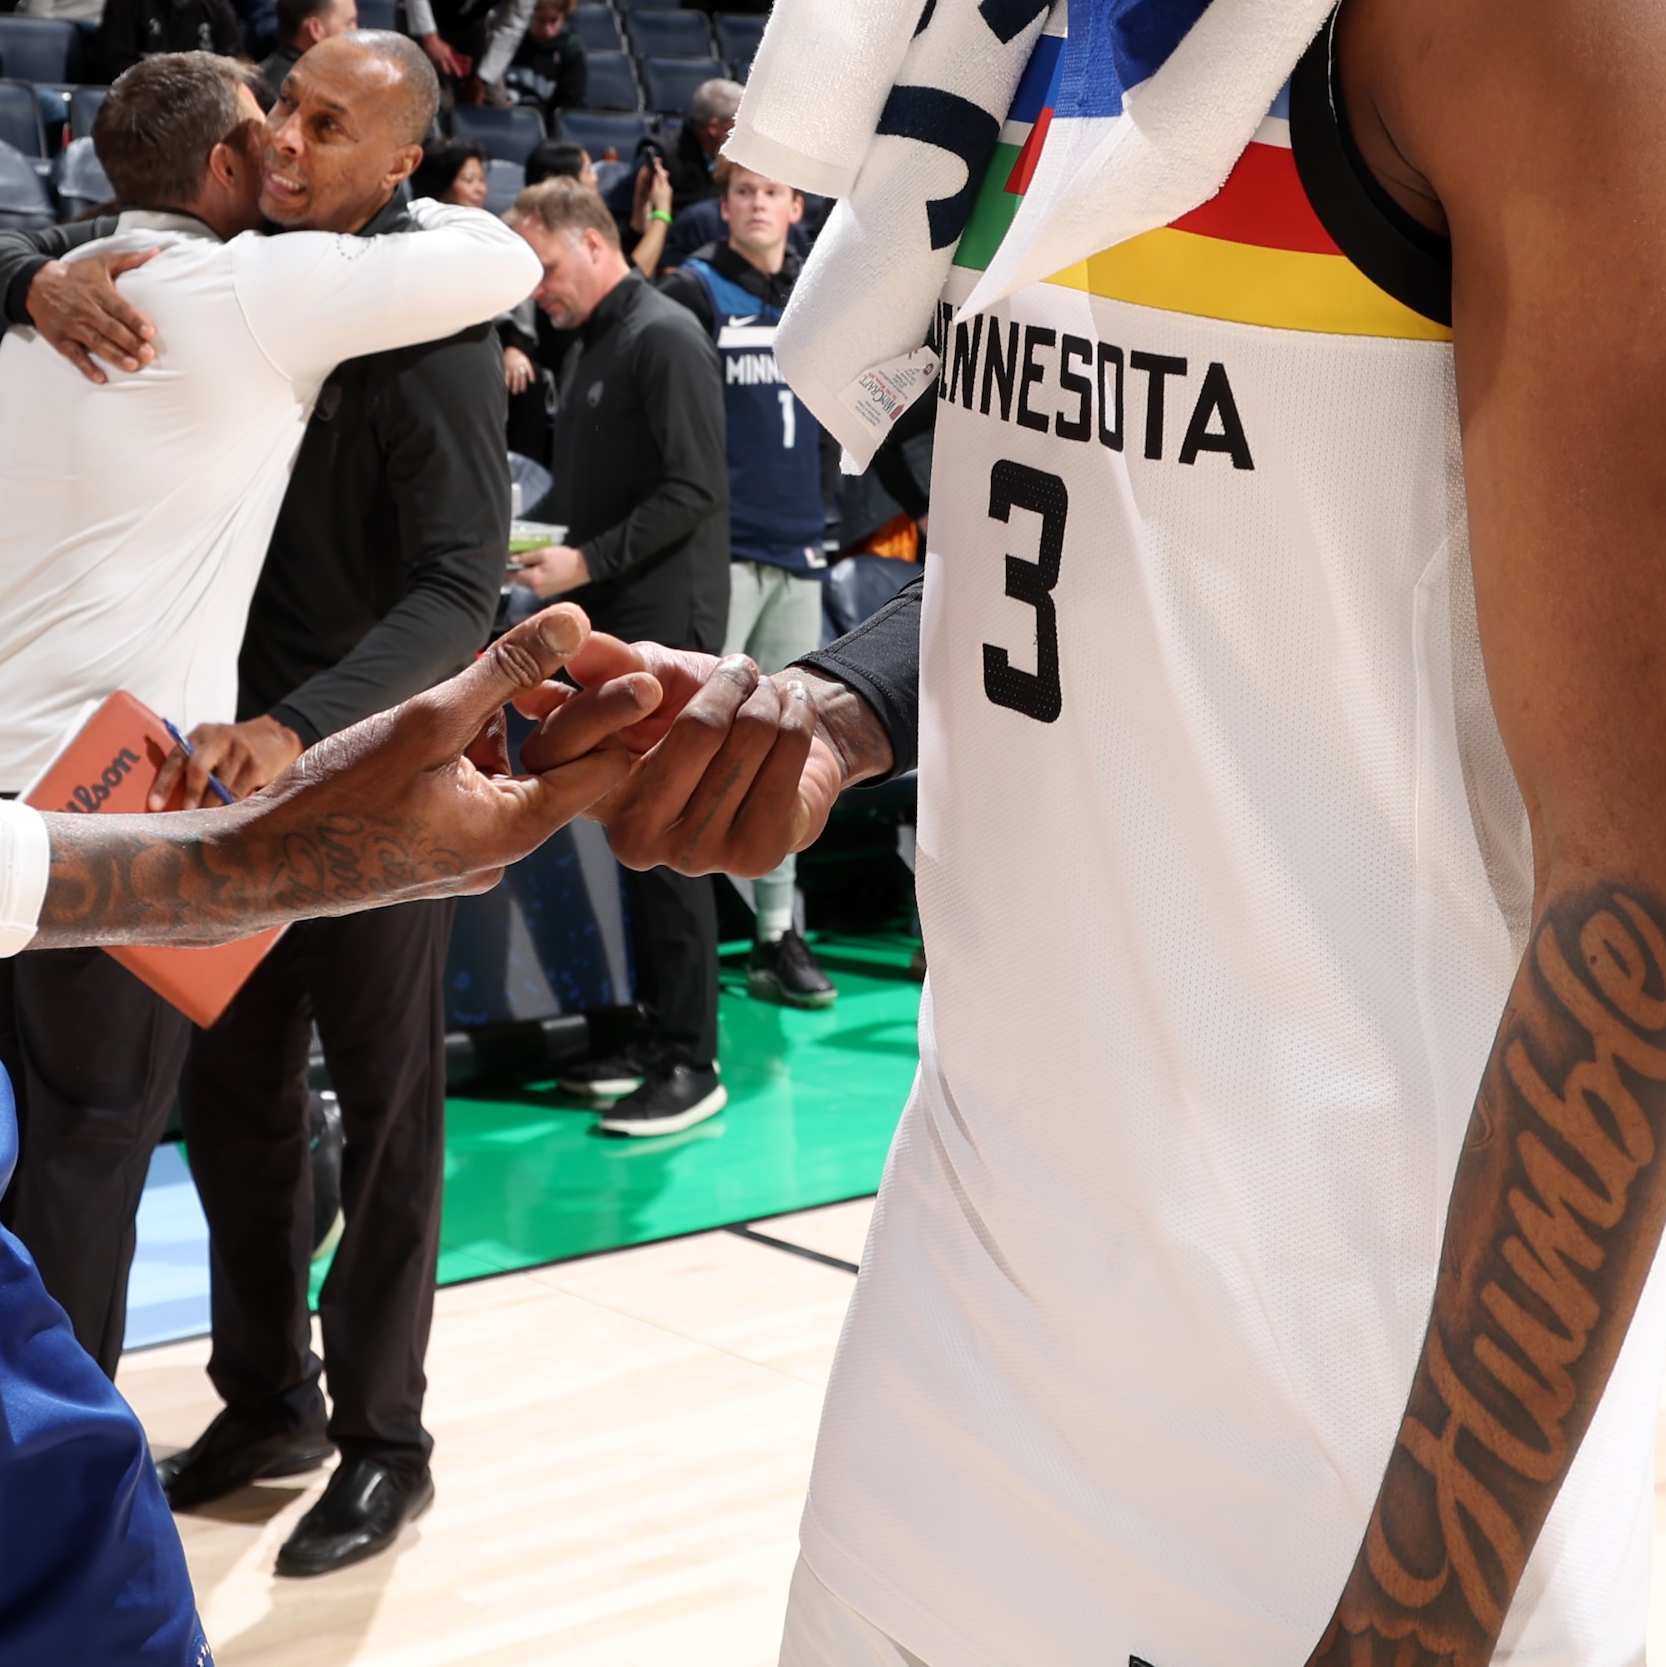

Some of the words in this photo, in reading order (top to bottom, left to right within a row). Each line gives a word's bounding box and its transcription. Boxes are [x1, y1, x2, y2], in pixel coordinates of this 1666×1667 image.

[778, 389, 796, 449] 1
[933, 299, 1255, 470] INNESOTA
[983, 459, 1068, 723] 3
